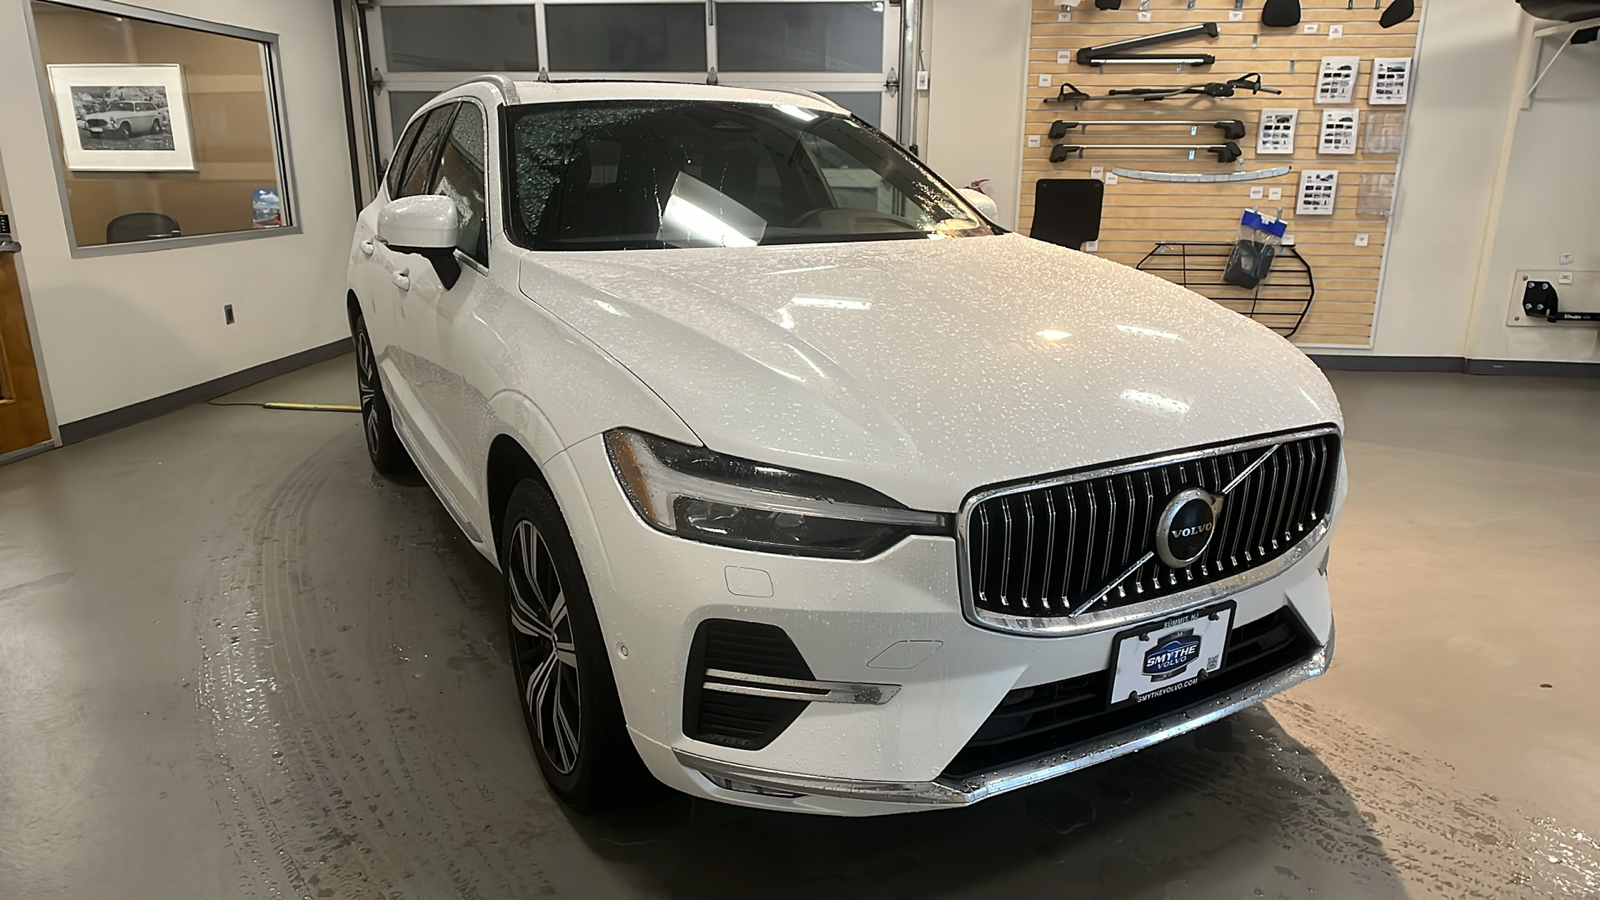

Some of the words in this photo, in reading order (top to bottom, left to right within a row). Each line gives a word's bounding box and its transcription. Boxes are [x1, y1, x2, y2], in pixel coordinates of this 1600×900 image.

[1172, 522, 1212, 538] VOLVO
[1146, 645, 1197, 667] SMYTHE
[1157, 656, 1187, 669] VOLVO
[1137, 678, 1198, 703] SMYTHEVOLVO.COM
